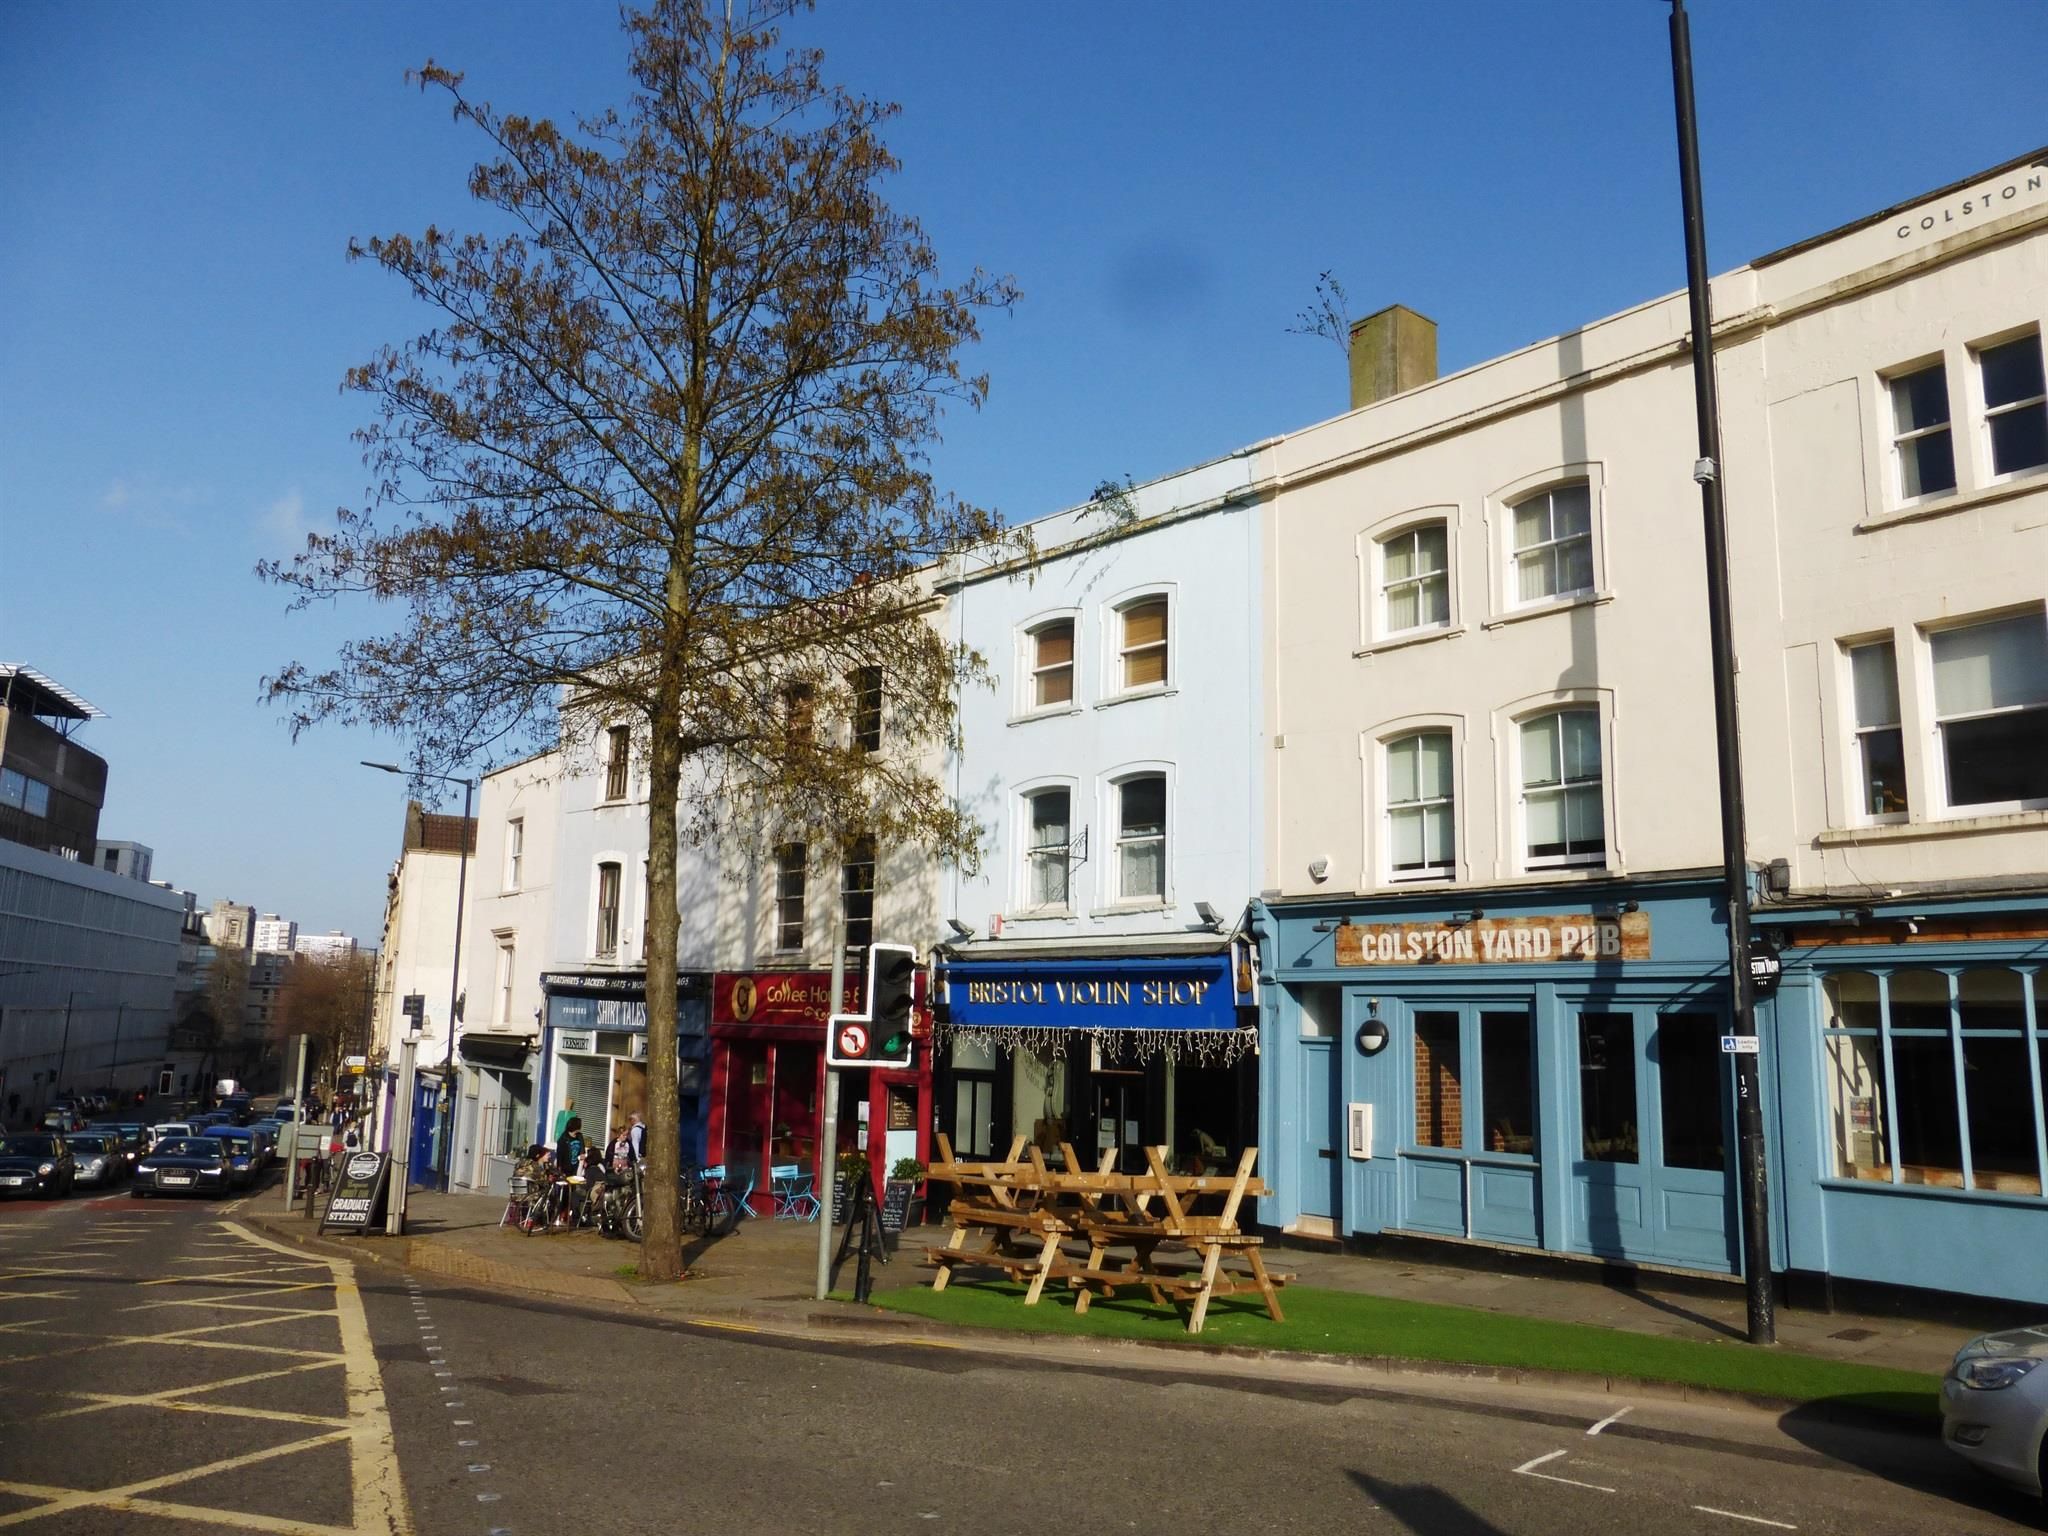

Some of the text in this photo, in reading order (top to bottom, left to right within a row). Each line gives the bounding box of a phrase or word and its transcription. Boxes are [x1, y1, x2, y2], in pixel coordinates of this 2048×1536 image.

[1896, 174, 2042, 239] COLSTON
[1361, 924, 1621, 961] COLSTON YARD PUB
[545, 975, 579, 986] SWEATSHIRTS
[583, 976, 606, 987] JACKETS
[610, 978, 626, 989] HATS
[677, 976, 689, 986] AGS
[766, 978, 807, 1003] Coffee
[810, 986, 851, 1003] Hoe
[968, 981, 1208, 1006] BRISTOL VIOLIN SHOP
[597, 1000, 646, 1027] SHIRT TALES
[328, 1212, 366, 1221] STYLISTS
[332, 1198, 371, 1211] GRADUATE
